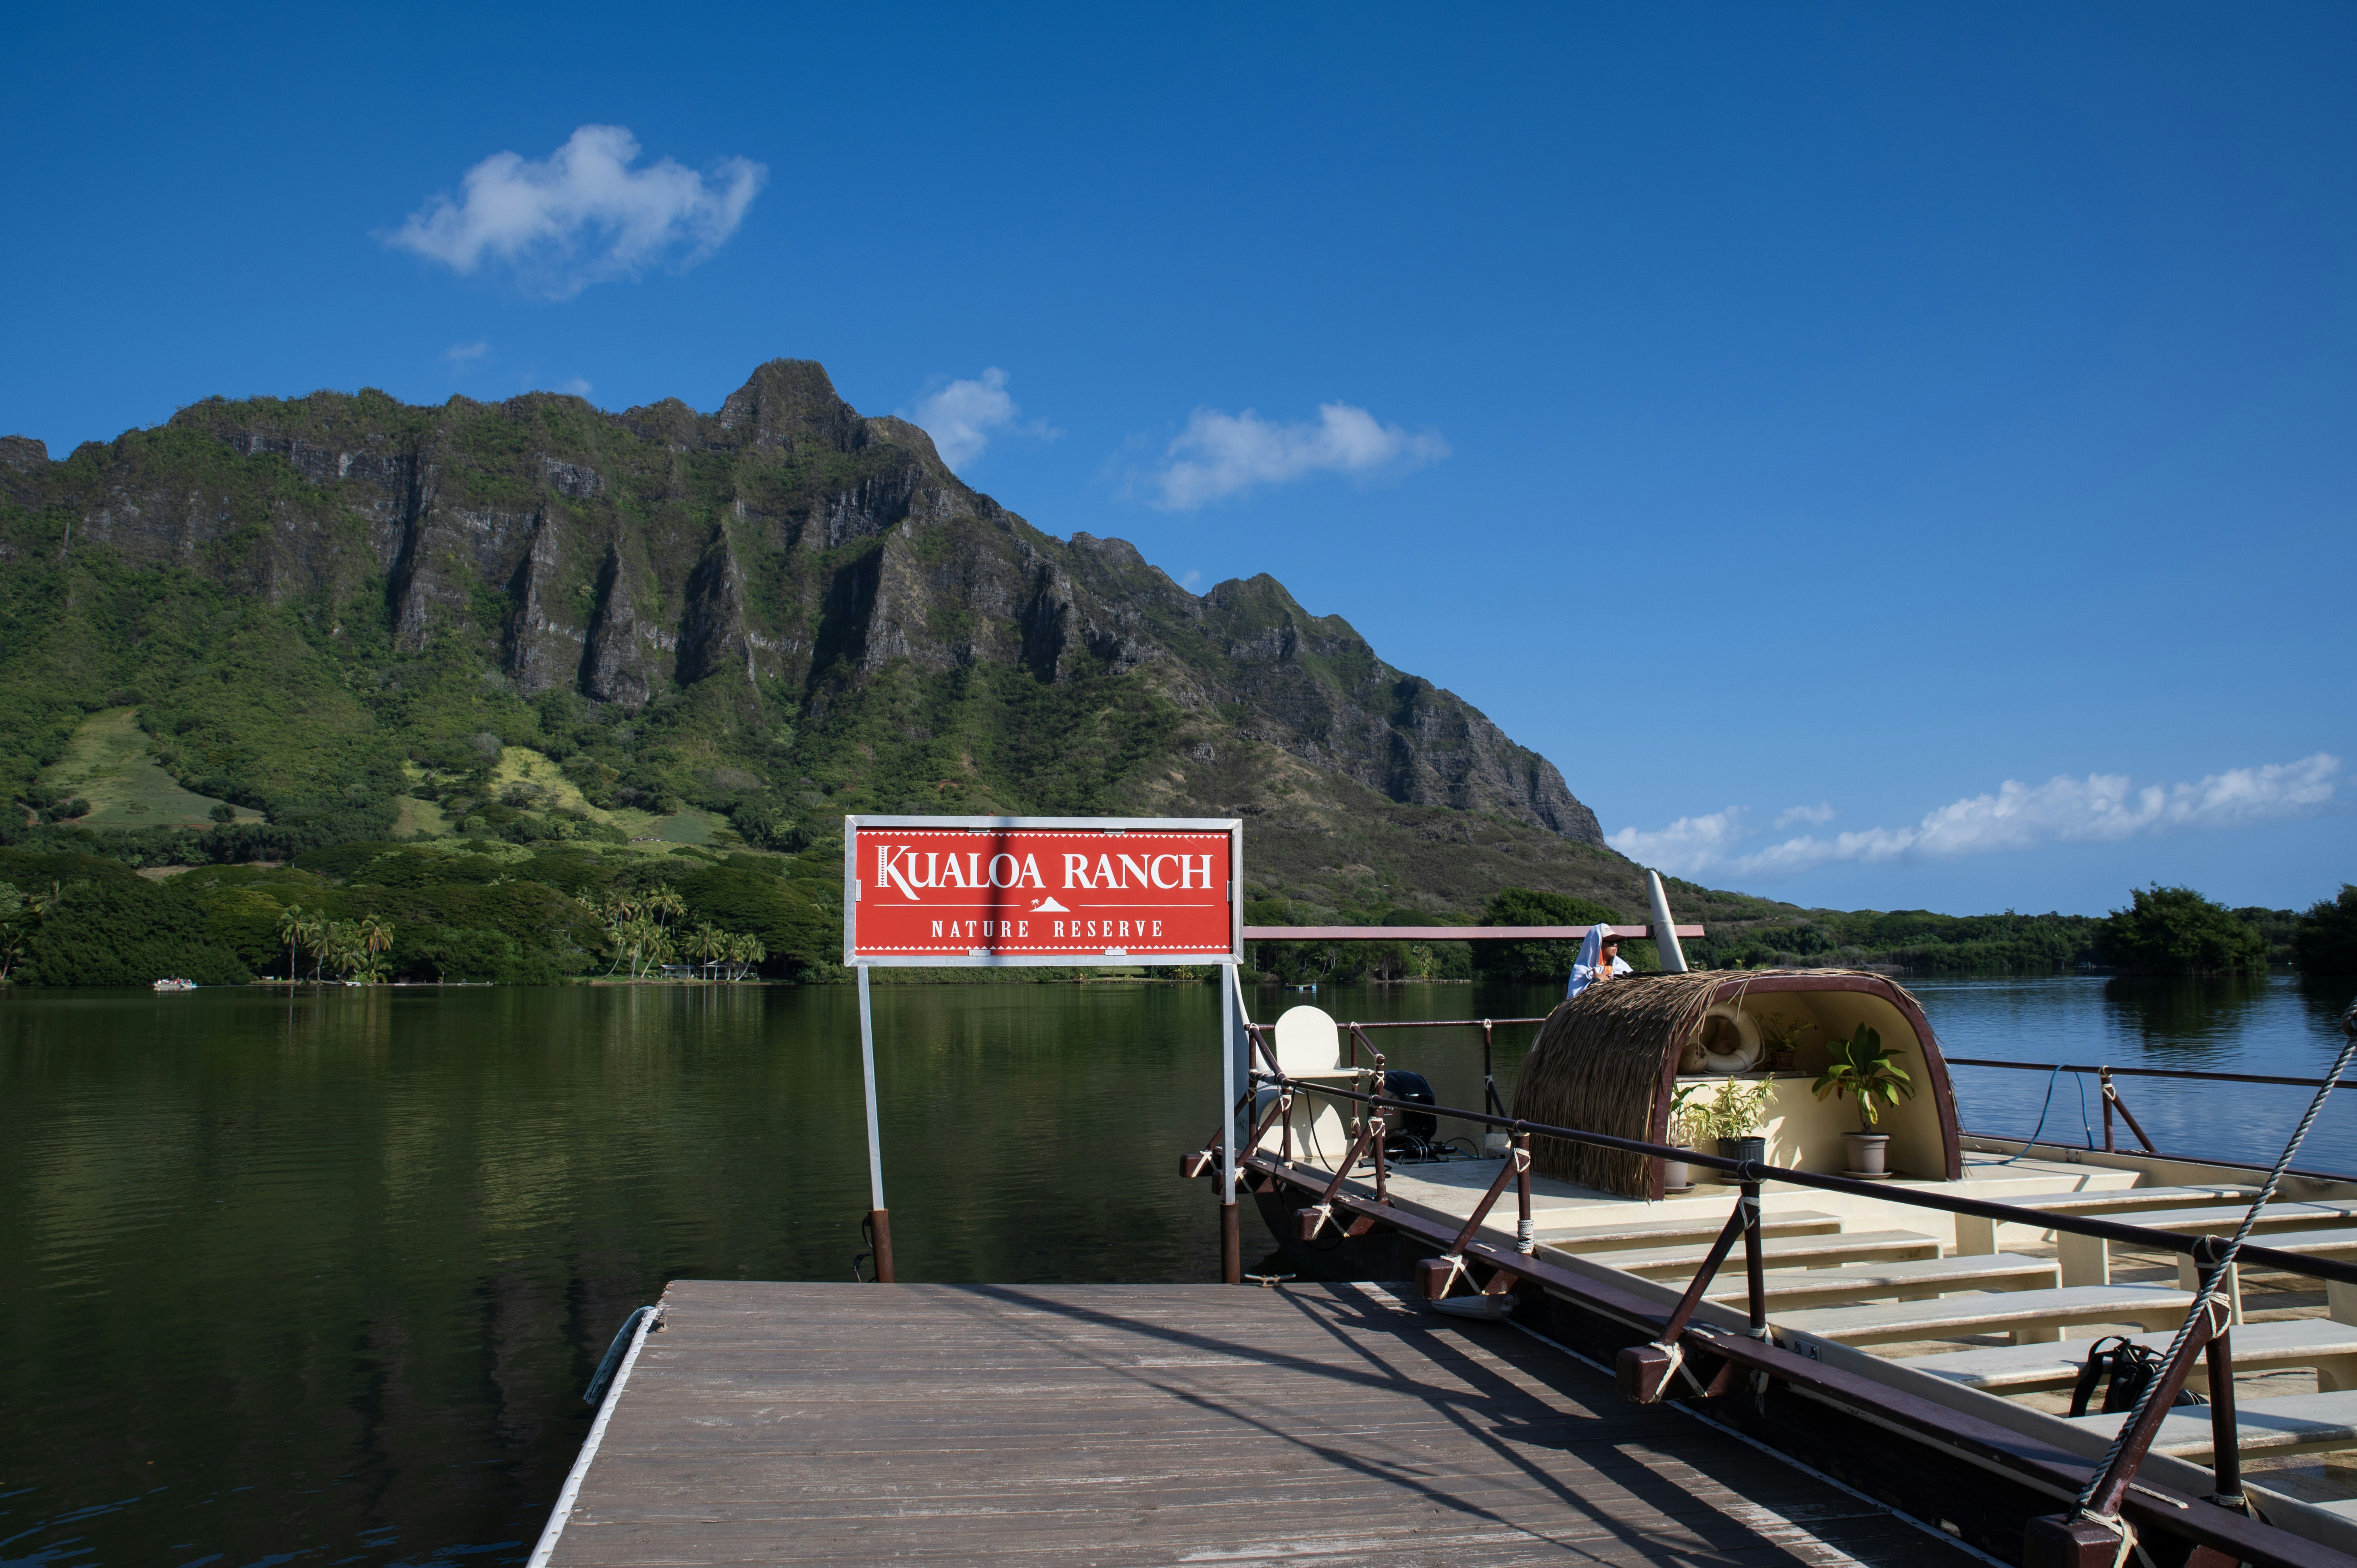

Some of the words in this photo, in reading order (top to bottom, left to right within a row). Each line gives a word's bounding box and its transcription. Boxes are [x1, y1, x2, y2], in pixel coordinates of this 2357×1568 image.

[874, 845, 1047, 900] KUALOA
[1061, 853, 1214, 889] RANCH
[931, 920, 1028, 938] NATURE
[1053, 920, 1162, 938] RESERVE
